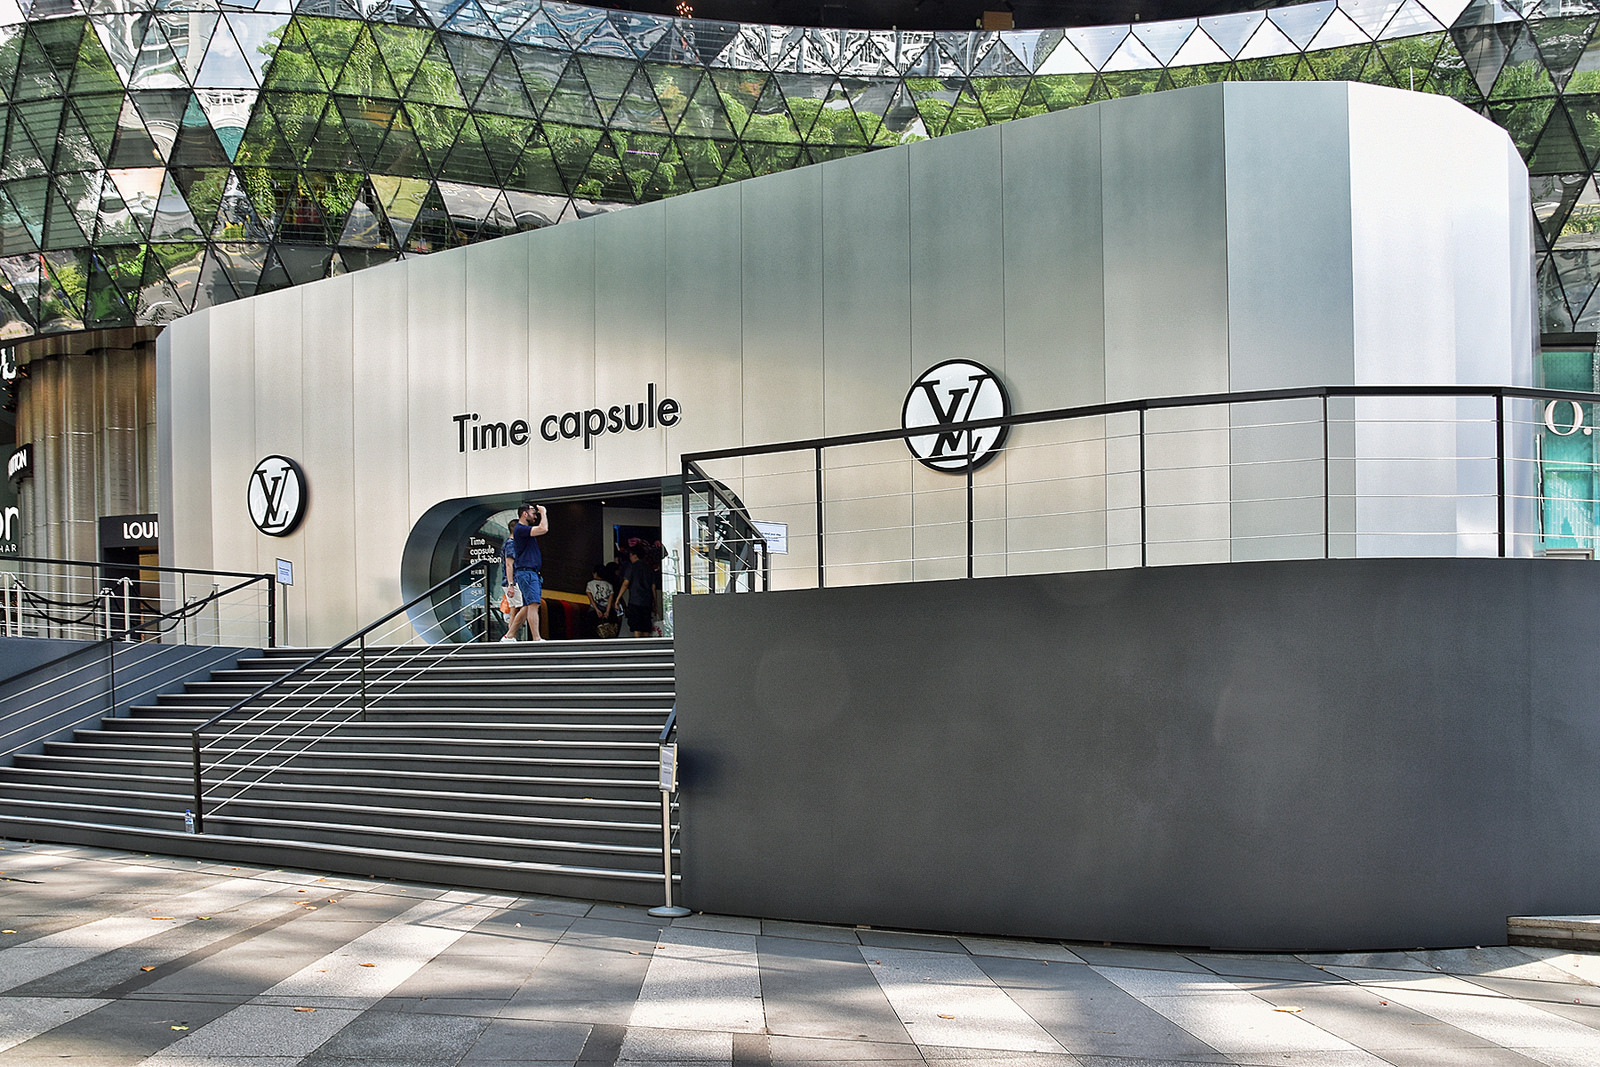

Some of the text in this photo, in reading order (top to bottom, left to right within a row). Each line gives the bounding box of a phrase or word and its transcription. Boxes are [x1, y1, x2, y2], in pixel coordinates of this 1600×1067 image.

[453, 382, 680, 453] Time capsule
[469, 537, 486, 546] Time
